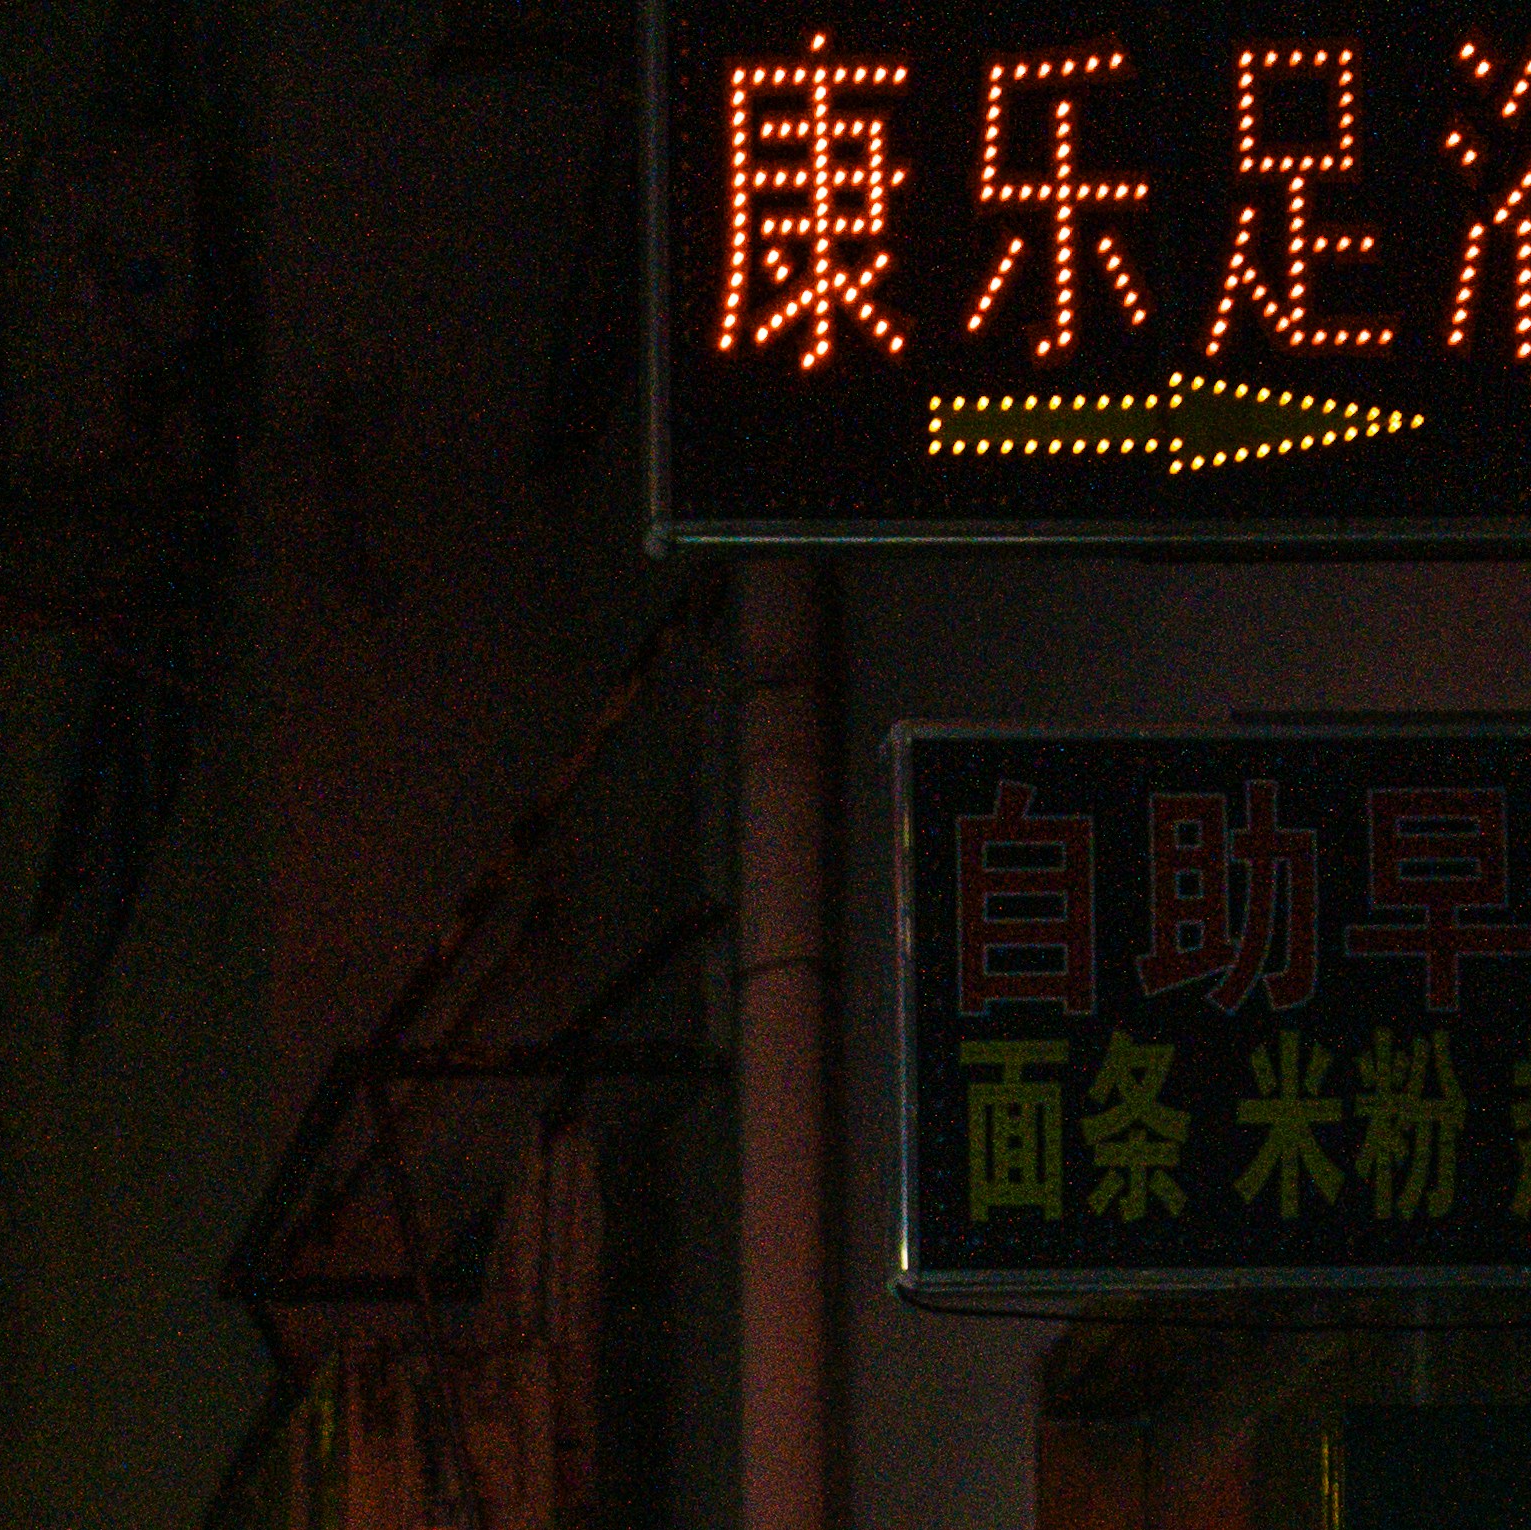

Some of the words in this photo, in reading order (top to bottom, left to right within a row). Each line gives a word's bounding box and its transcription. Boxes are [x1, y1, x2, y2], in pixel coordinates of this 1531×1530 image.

[954, 778, 1531, 1017] 自助早
[958, 1028, 1192, 1222] 面条
[1234, 1028, 1468, 1222] 米粉
